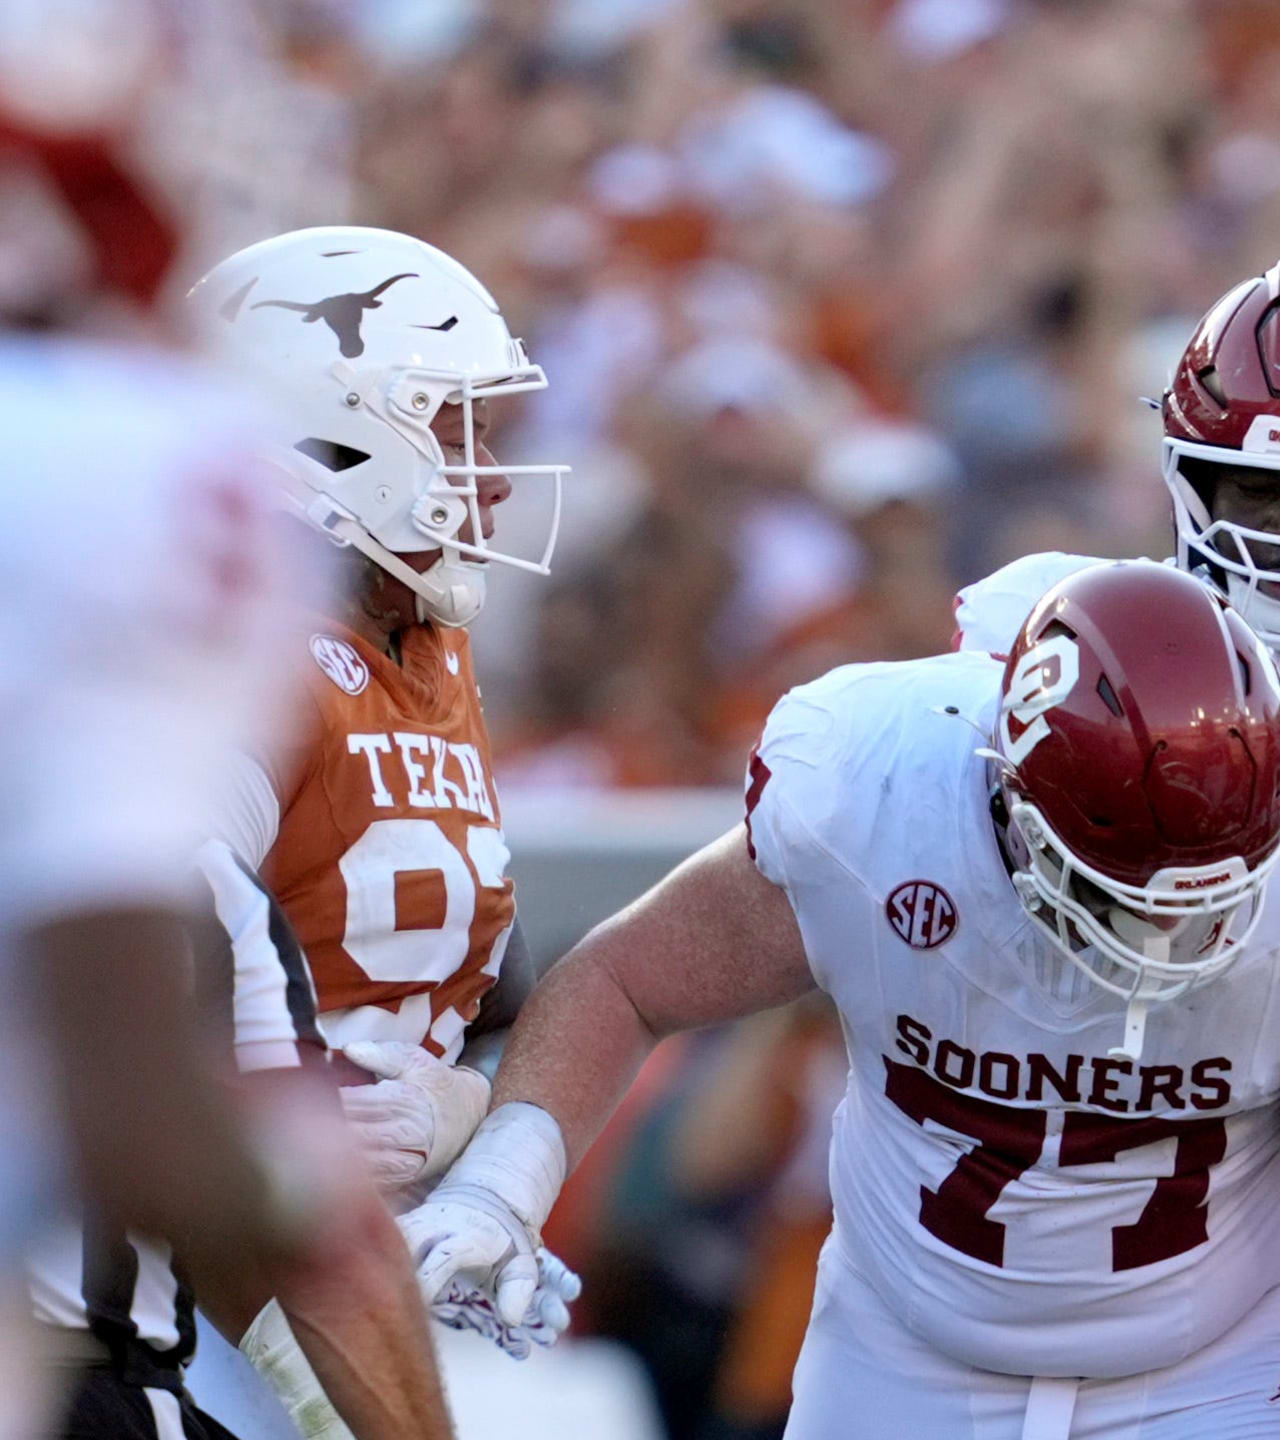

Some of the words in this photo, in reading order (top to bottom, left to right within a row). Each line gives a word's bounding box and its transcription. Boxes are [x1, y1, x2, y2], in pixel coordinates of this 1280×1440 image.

[347, 731, 500, 824] TEXA
[888, 884, 955, 947] SEC
[1174, 872, 1231, 890] OKLAHOMA
[895, 1014, 1232, 1112] SOONERS
[883, 1053, 1228, 1273] 77
